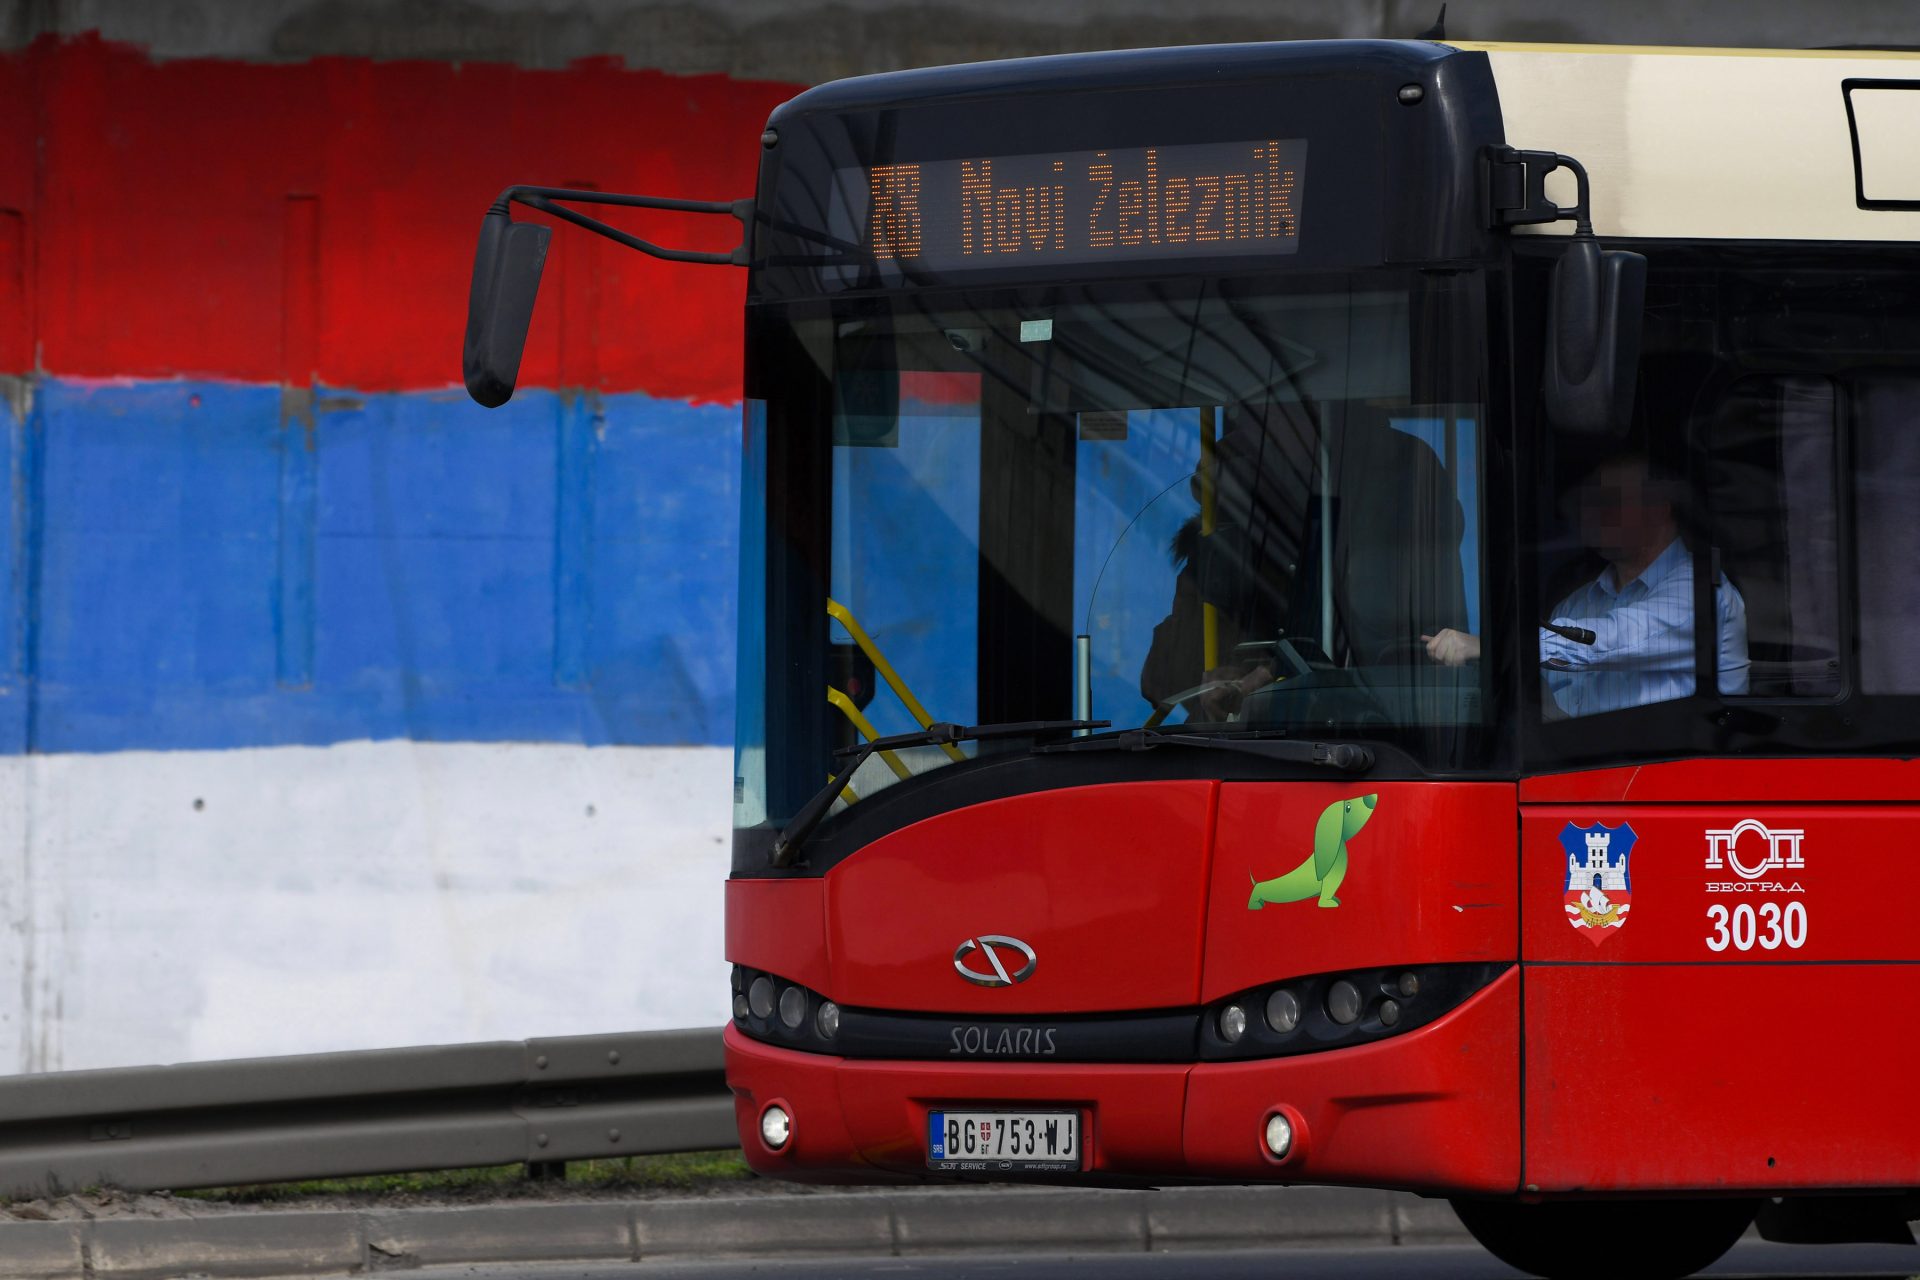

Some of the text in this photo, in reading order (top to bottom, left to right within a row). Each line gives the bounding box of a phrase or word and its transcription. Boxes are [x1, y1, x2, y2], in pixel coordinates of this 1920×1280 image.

[871, 139, 1296, 260] 88 Novi Železnik
[1705, 818, 1805, 880] ГСП
[1705, 881, 1806, 894] БЕОГРАД
[1705, 900, 1808, 952] 3030
[949, 1025, 1057, 1055] SOLARIS
[932, 1144, 944, 1154] SRB
[960, 1162, 987, 1170] SERVICE
